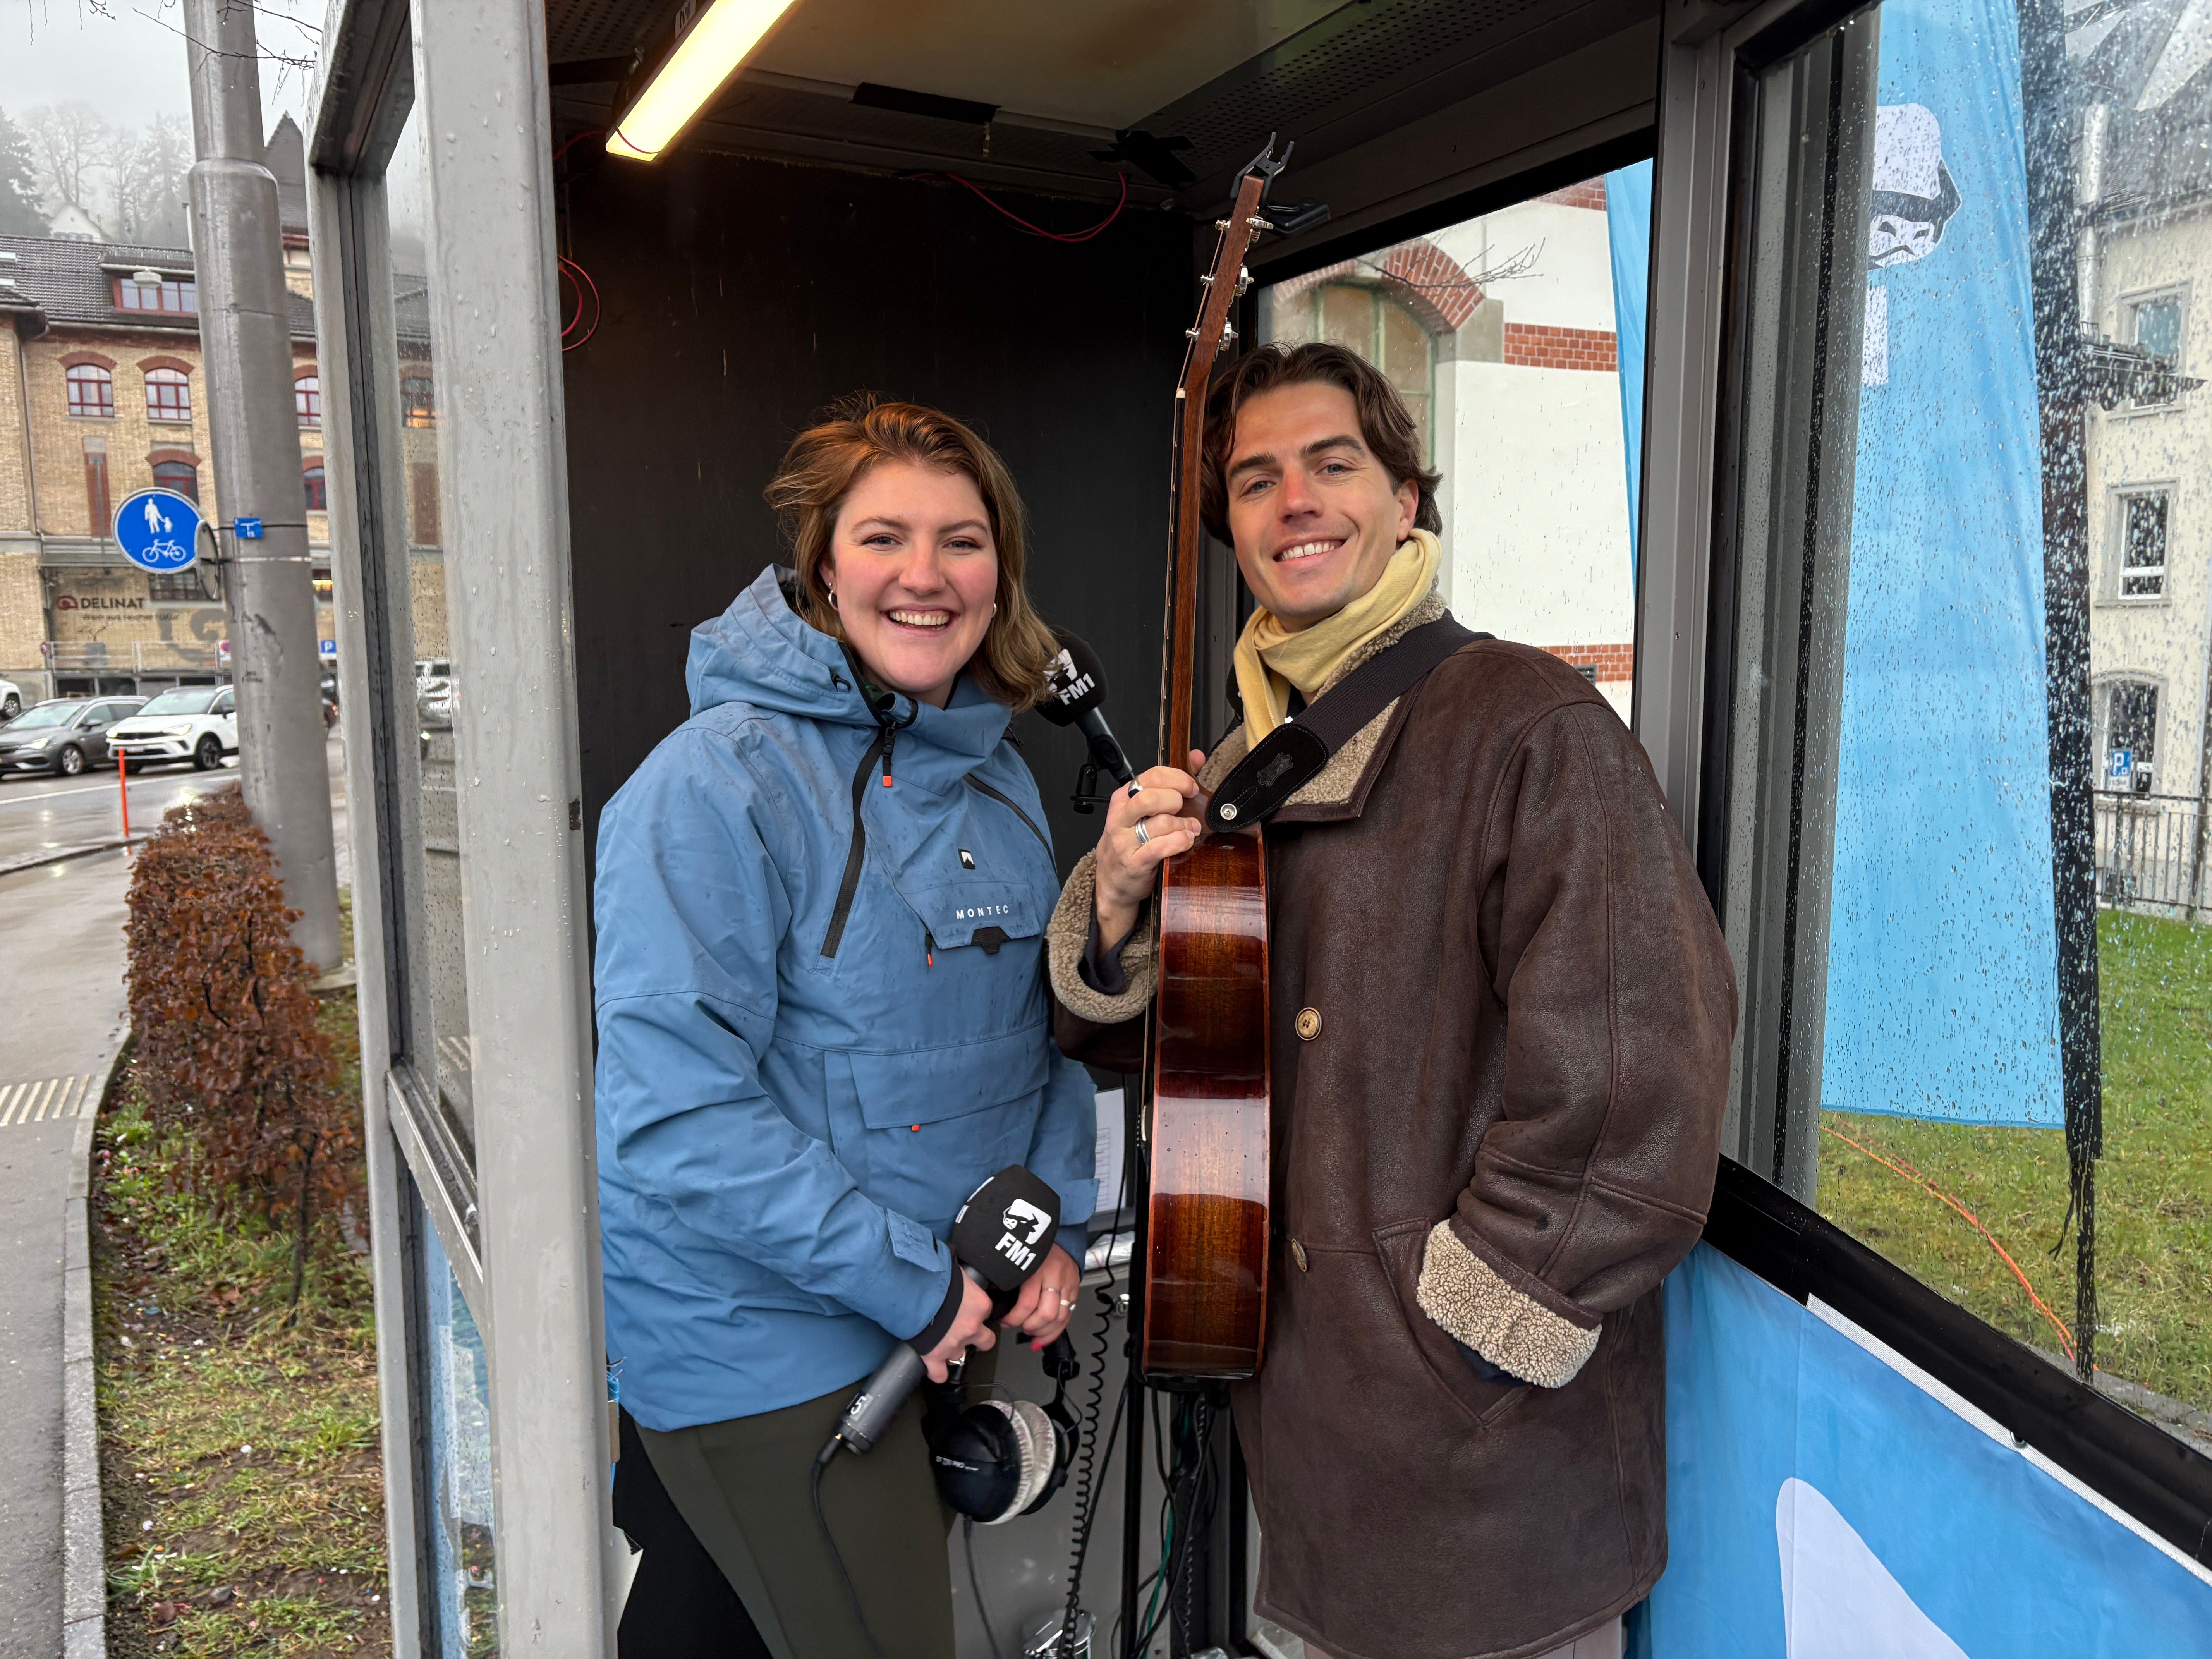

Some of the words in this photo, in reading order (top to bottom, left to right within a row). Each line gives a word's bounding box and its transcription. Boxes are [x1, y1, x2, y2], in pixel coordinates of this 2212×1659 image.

[81, 598, 144, 609] DELINAT
[325, 641, 333, 652] P
[1058, 673, 1095, 705] FM1
[2113, 752, 2124, 775] P
[956, 905, 1008, 919] MONTEC
[994, 1231, 1037, 1271] FM1
[851, 1396, 867, 1415] 5
